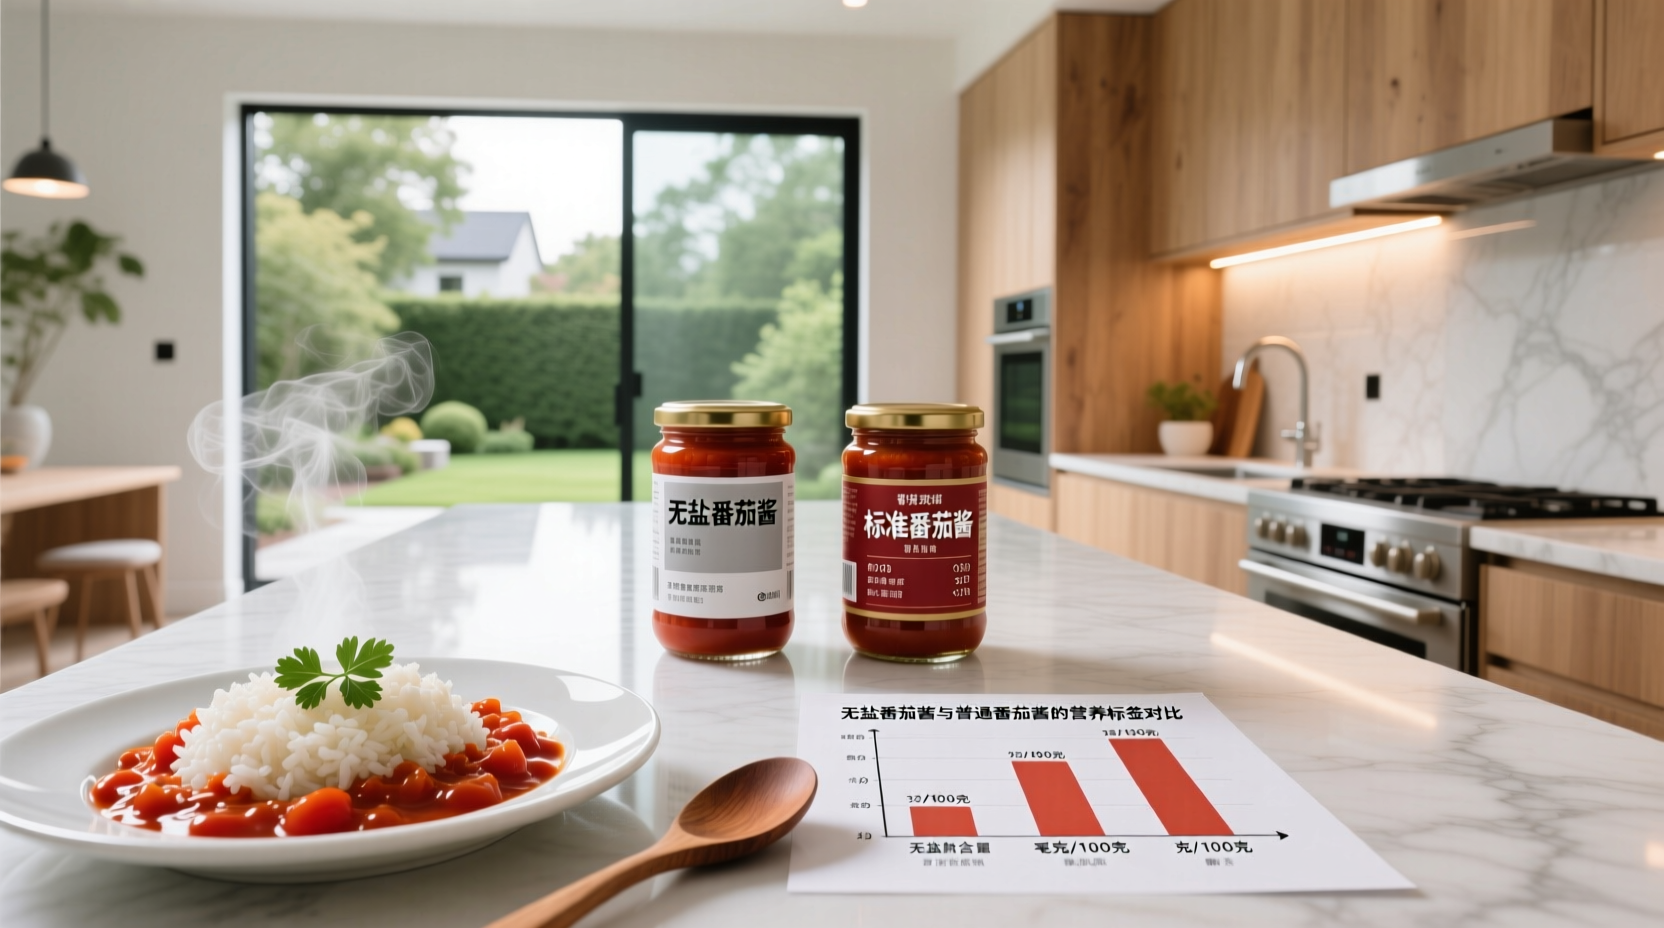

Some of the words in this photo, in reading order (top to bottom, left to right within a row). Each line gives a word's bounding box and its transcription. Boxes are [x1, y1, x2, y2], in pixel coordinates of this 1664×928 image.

[668, 498, 778, 527] 无盐番茄酱
[863, 508, 974, 540] 标准番茄酱
